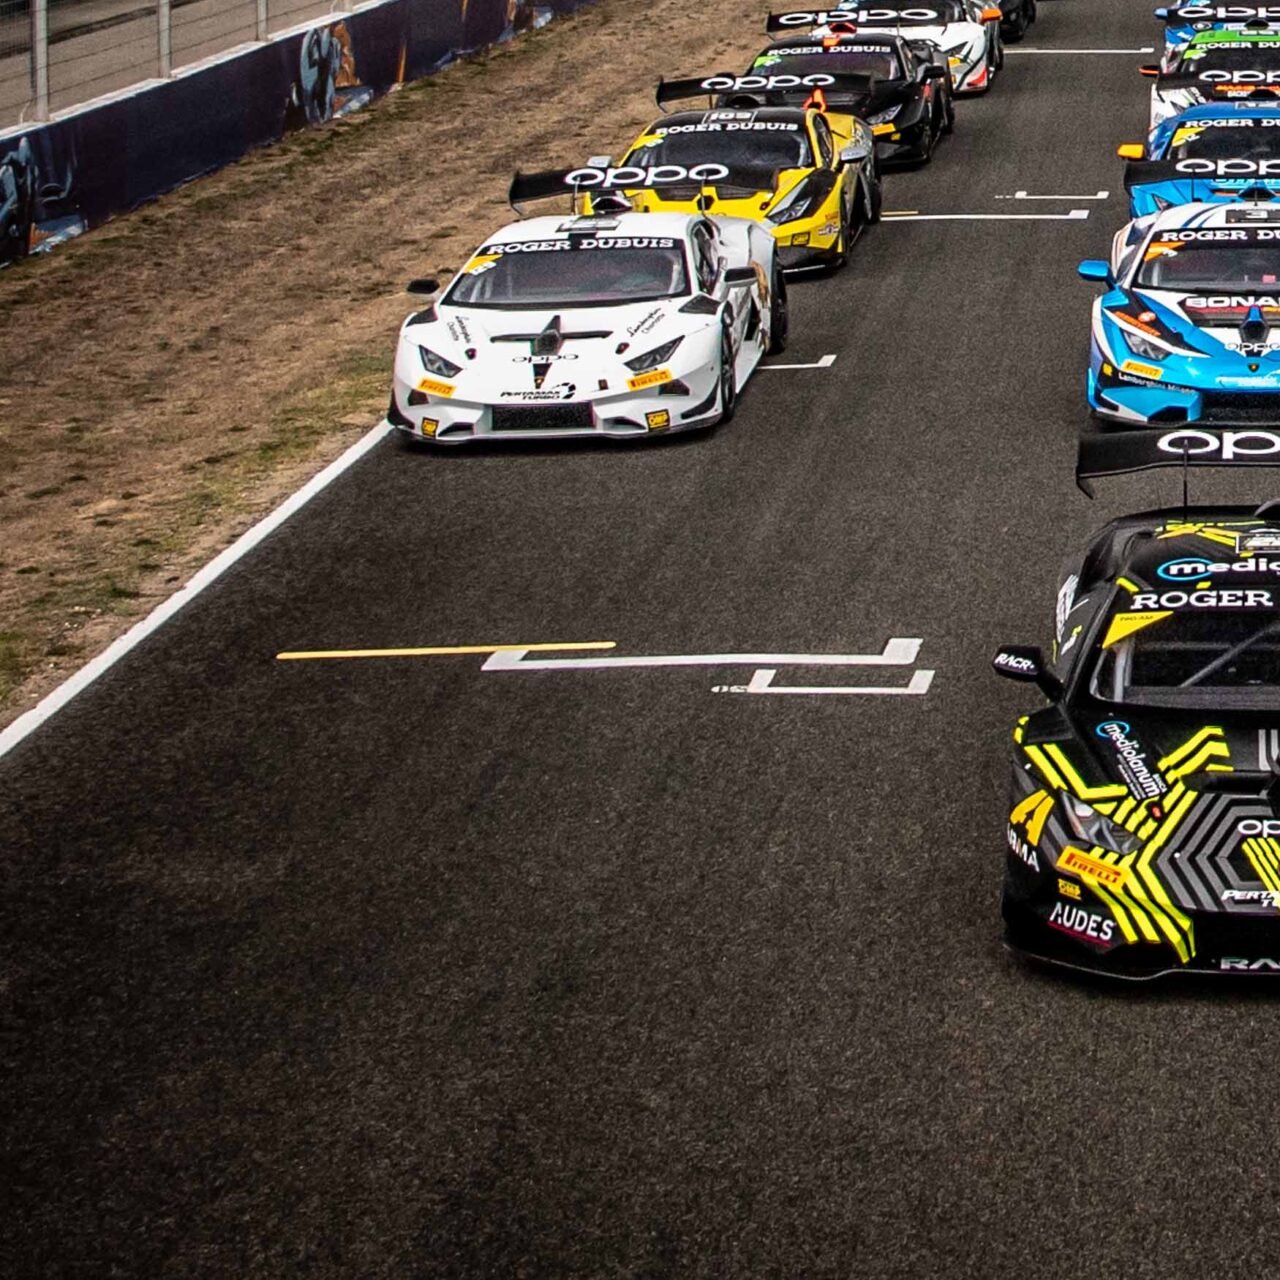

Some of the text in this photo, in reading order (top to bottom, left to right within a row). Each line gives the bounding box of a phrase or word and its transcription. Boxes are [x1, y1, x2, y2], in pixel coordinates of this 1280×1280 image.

[767, 45, 891, 56] ROGER DUBUIS
[1196, 42, 1253, 50] ROGER
[701, 73, 835, 91] oppo
[655, 122, 798, 135] ROGER DUBUIS
[1184, 120, 1253, 128] ROGER
[564, 163, 729, 188] oppo
[1160, 230, 1248, 242] ROGER
[487, 238, 674, 255] ROGER DUBUIS
[1130, 590, 1273, 609] ROGER
[1104, 724, 1160, 797] mediolanum
[1065, 852, 1122, 884] PIRELLI
[1050, 902, 1115, 940] AUDES
